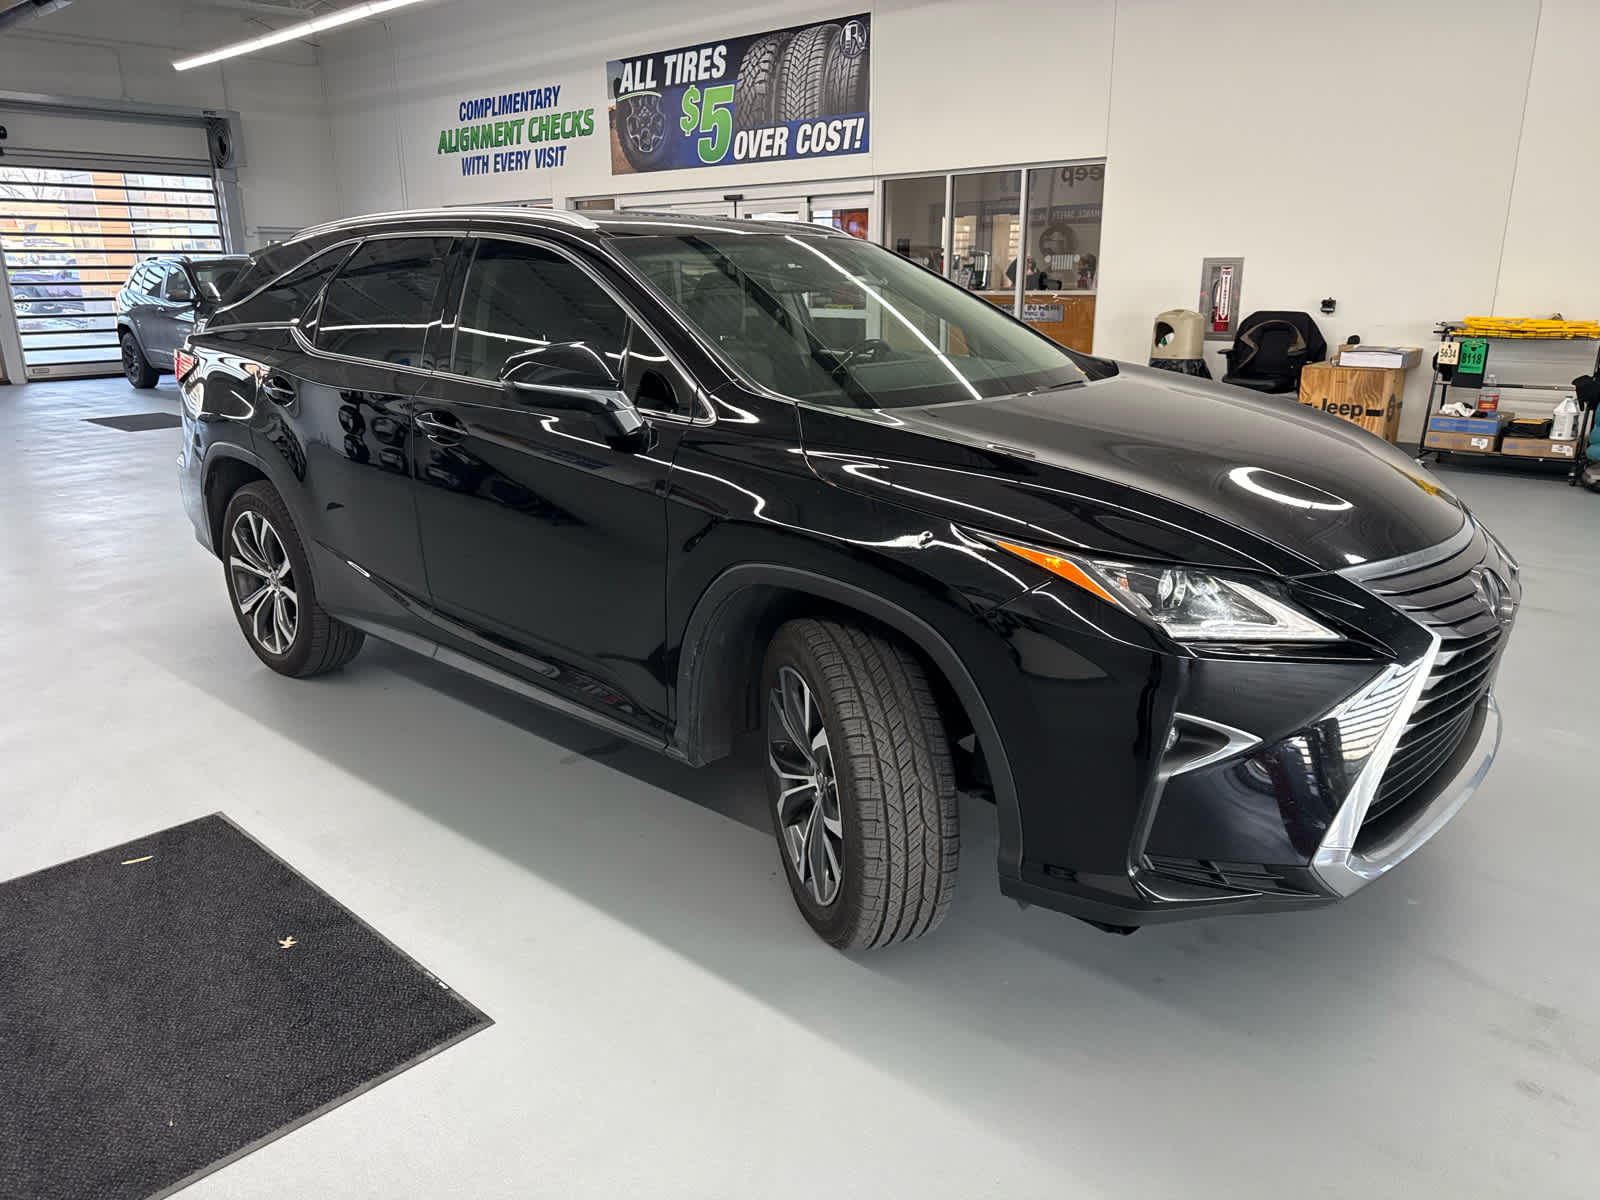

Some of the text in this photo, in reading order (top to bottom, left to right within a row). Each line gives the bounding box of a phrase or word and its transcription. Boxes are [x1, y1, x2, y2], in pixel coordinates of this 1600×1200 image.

[620, 45, 727, 93] ALL TIRES
[459, 85, 560, 122] COMPLIMENTARY
[438, 108, 594, 154] ALIGNMENT CHECKS
[680, 84, 735, 164] $5
[733, 118, 865, 160] OVER COST!
[462, 145, 567, 177] WITH EVERY VISIT
[1461, 352, 1482, 365] 8118
[1313, 398, 1363, 419] Jeep
